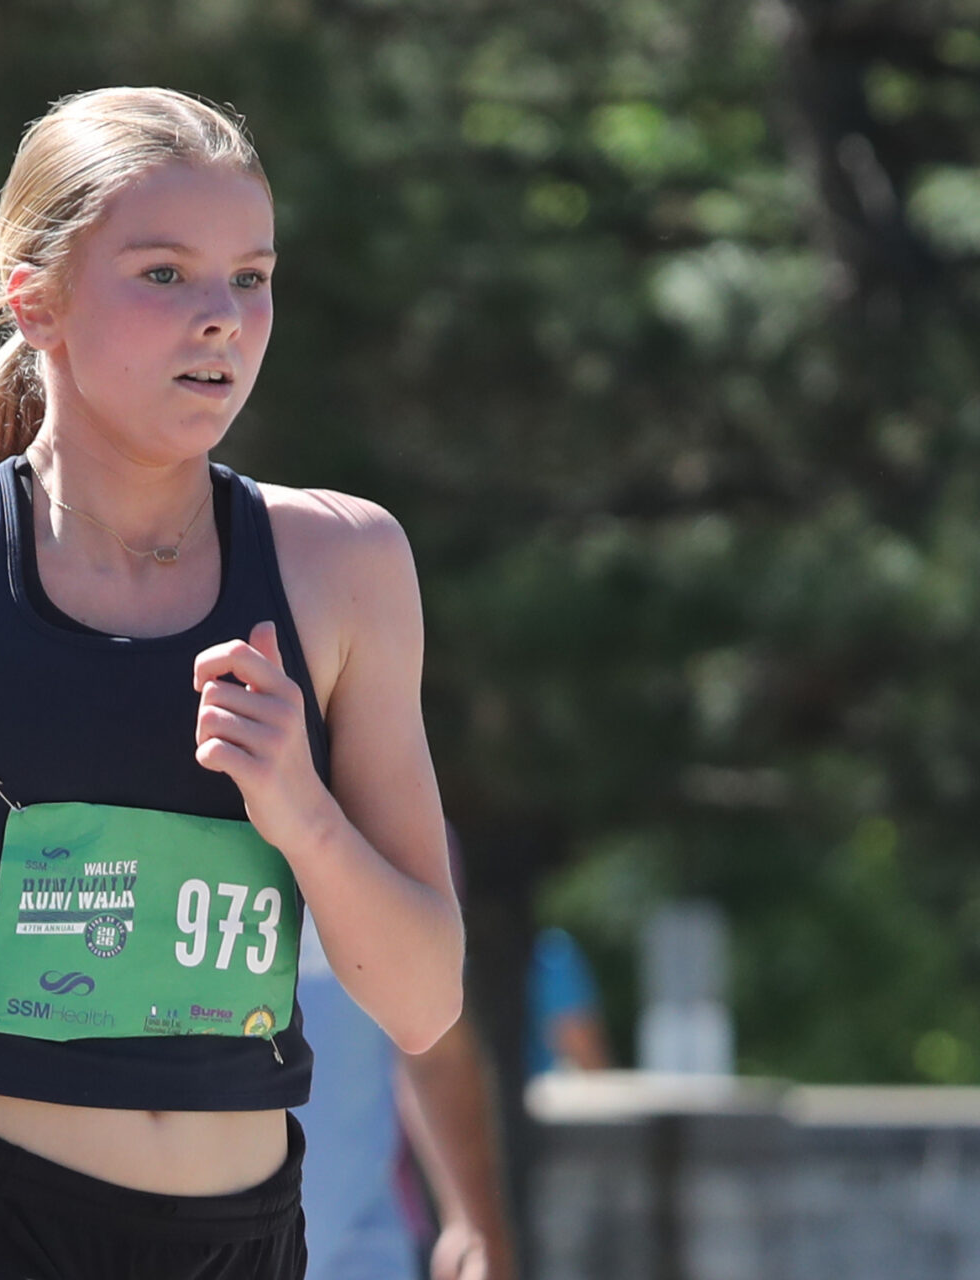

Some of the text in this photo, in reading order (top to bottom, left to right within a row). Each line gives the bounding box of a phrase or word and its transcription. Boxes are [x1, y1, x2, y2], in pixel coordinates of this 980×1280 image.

[84, 860, 138, 876] WALLEYE
[23, 924, 76, 933] 47TH ANNUAL
[175, 878, 282, 975] 973
